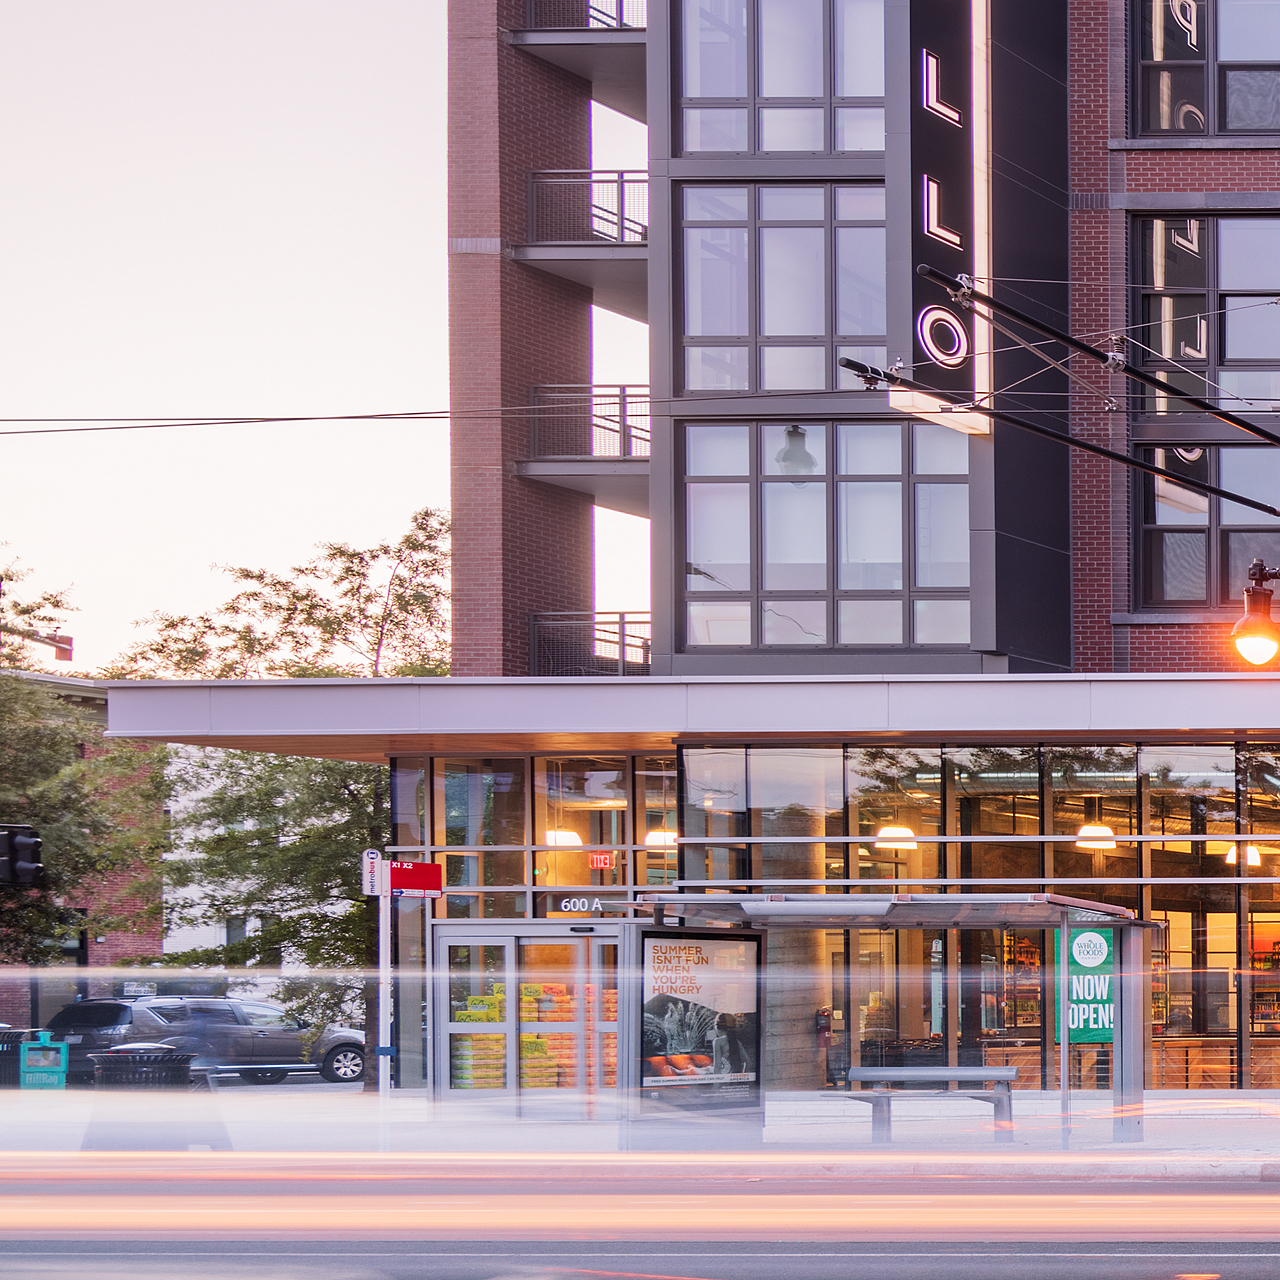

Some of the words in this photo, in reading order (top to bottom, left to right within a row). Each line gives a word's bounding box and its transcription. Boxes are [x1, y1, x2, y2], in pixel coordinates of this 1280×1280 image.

[402, 862, 414, 870] X2
[368, 861, 376, 894] metrobus
[561, 898, 589, 912] 600
[591, 897, 603, 912] A
[1076, 940, 1104, 949] WHOLE
[652, 945, 703, 955] SUMMER
[652, 955, 682, 965] ISN'T
[685, 956, 709, 965] FUN
[652, 965, 690, 974] WHEN
[652, 975, 697, 984] YOU'RE
[652, 985, 703, 995] HUNGRY
[1072, 974, 1110, 1000] NOW
[1068, 1003, 1114, 1029] OPEN!
[25, 1073, 58, 1085] HillRag
